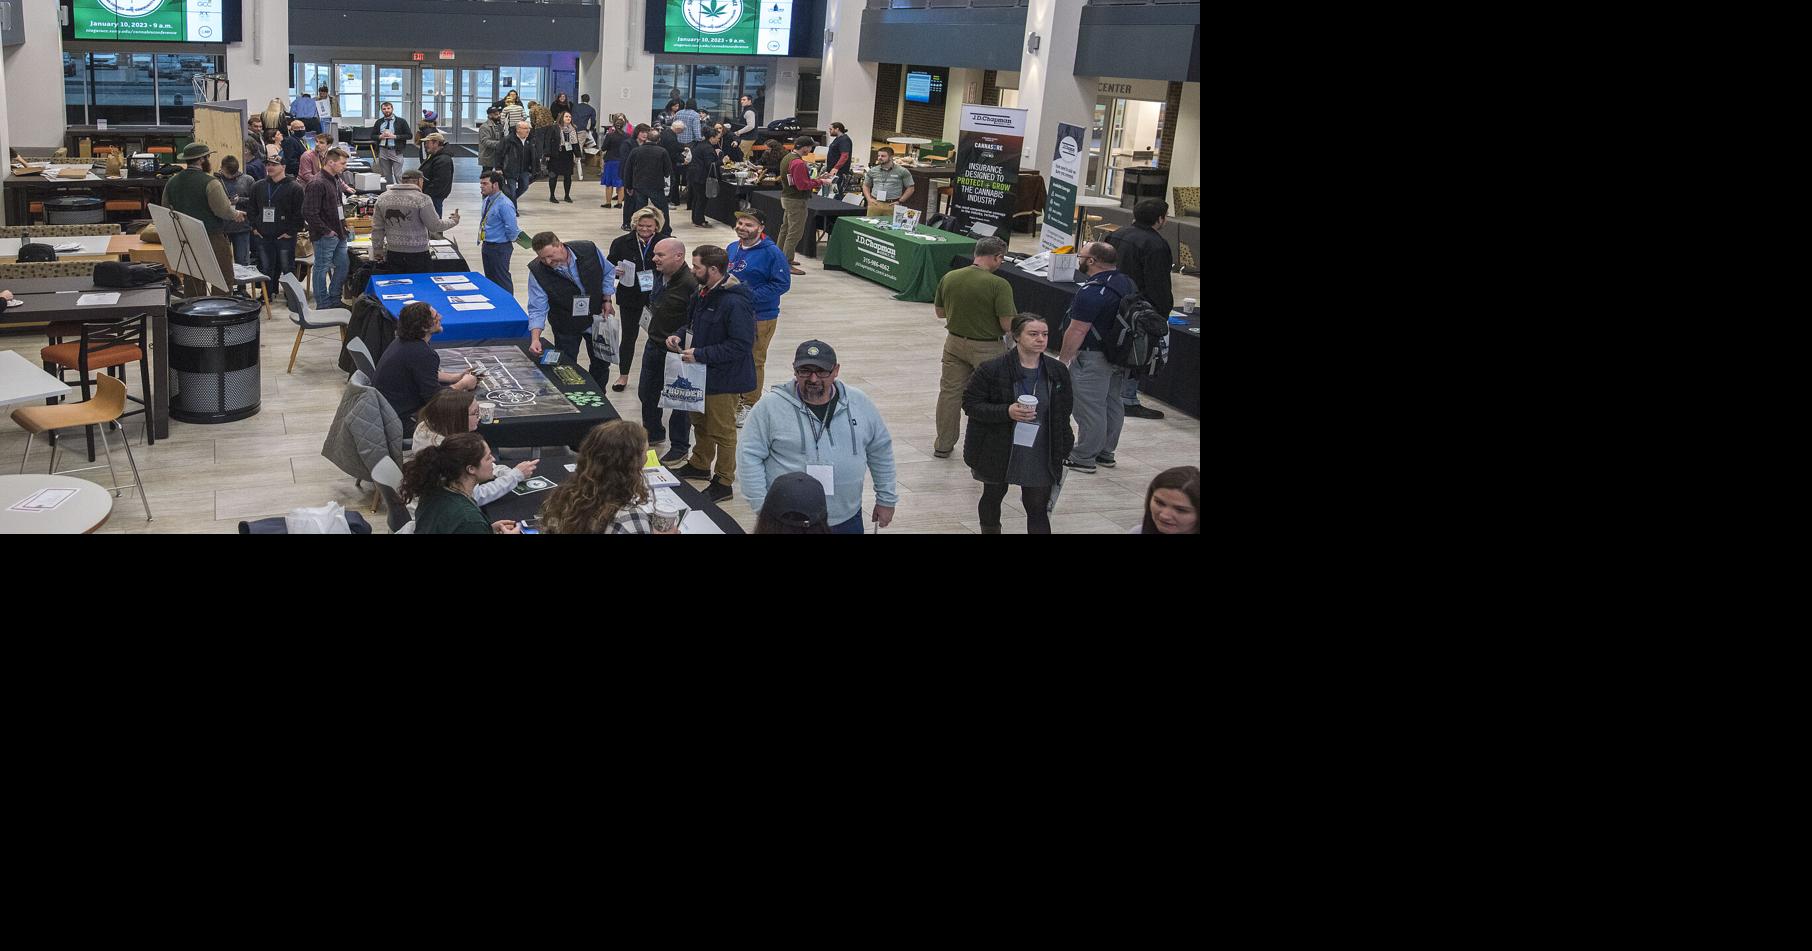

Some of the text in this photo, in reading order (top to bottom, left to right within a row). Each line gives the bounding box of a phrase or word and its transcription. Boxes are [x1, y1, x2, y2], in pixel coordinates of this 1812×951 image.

[1098, 82, 1132, 94] CENTER
[968, 162, 1003, 174] INSURANCE
[965, 170, 1004, 182] DESIGNED TO
[956, 176, 984, 188] PROTECT
[992, 182, 1010, 192] GROW
[962, 185, 1004, 199] THE CANNABIS
[968, 194, 996, 205] INDUSTRY
